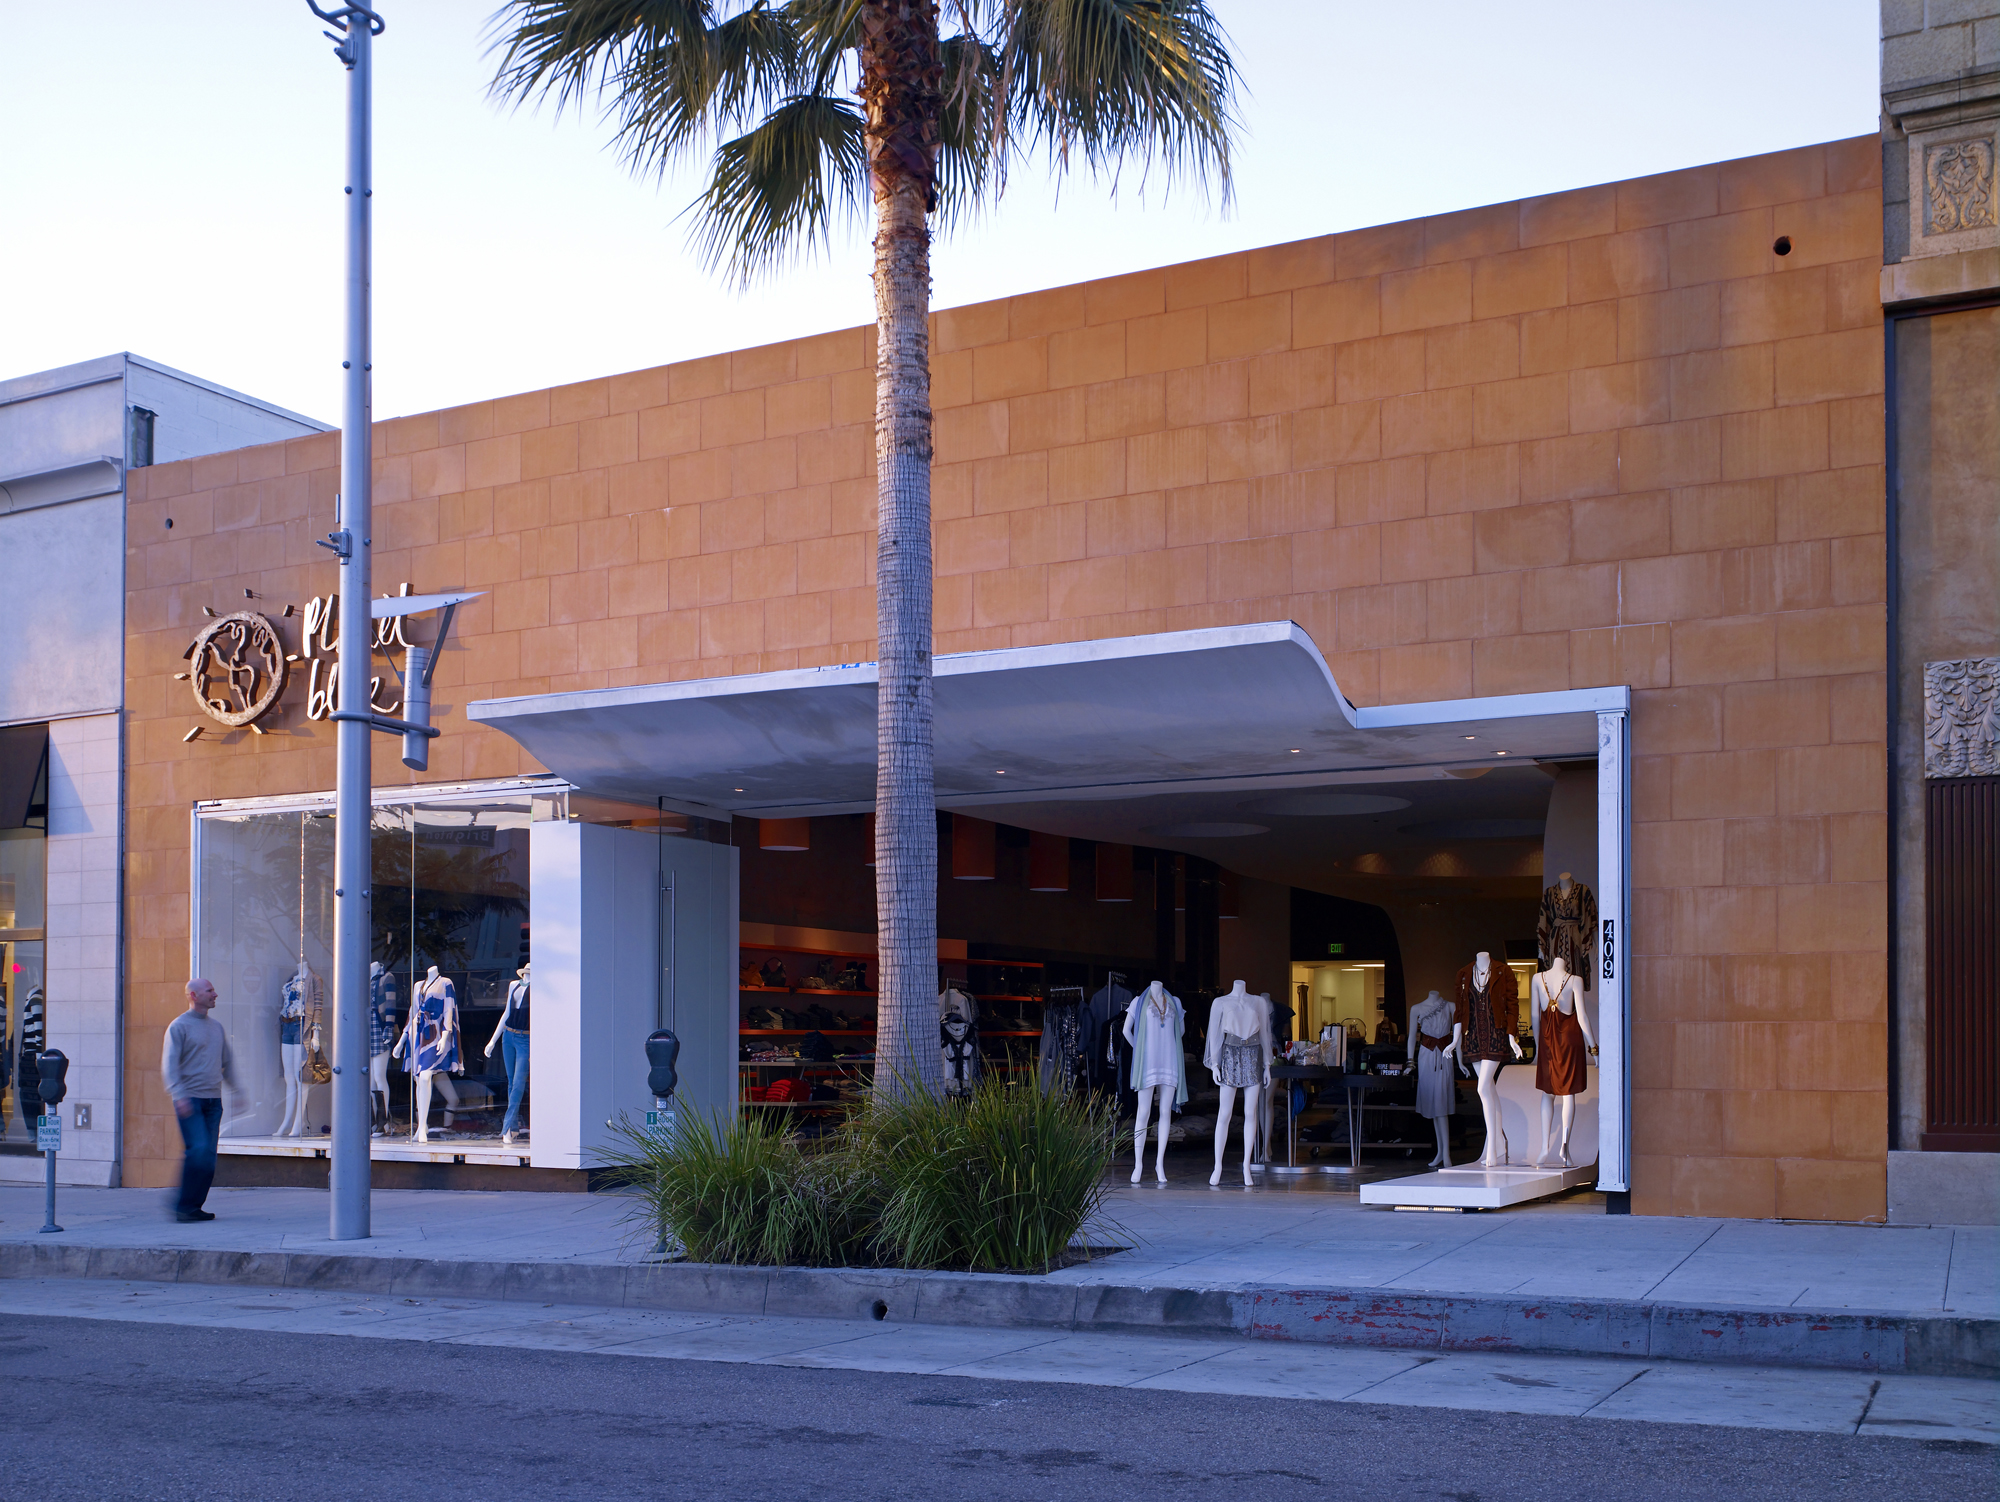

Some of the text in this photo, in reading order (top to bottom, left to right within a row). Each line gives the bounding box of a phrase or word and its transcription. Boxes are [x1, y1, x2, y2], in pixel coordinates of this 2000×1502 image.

[302, 583, 415, 658] Plet
[306, 658, 399, 720] ble
[1331, 943, 1342, 953] EXIT
[1604, 922, 1613, 977] 409
